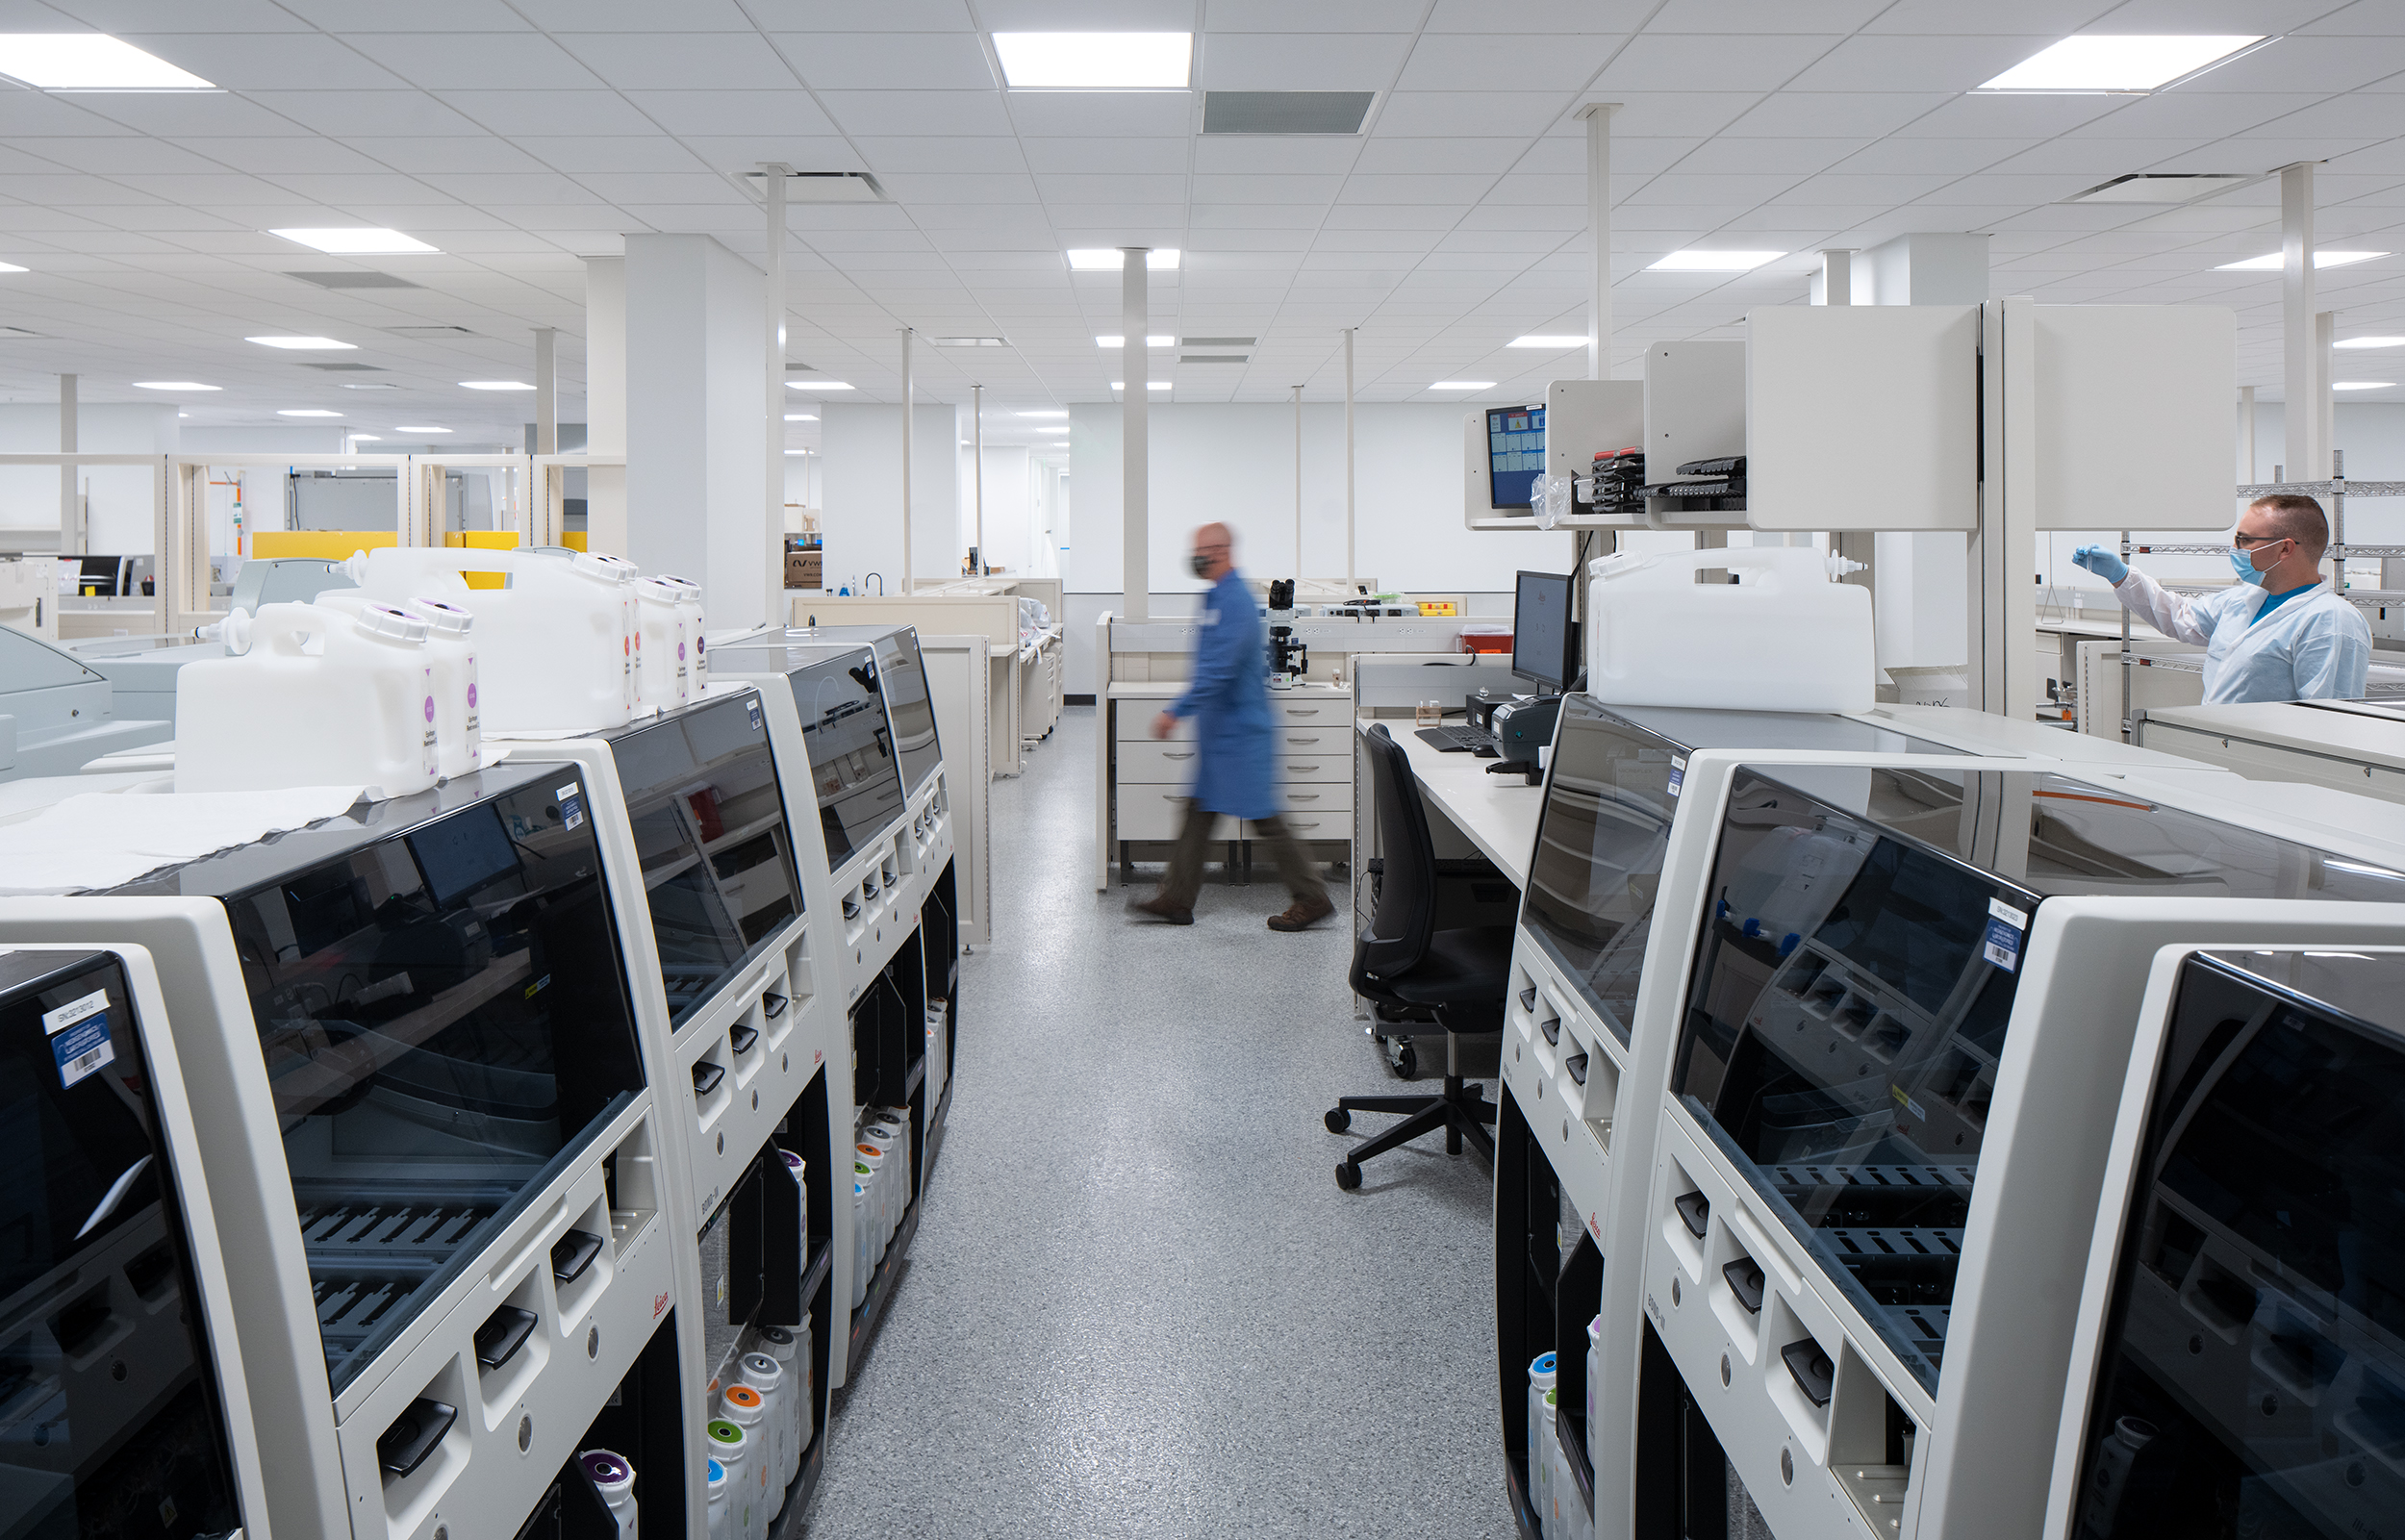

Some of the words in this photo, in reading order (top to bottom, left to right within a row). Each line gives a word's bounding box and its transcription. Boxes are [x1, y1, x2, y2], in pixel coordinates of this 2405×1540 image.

[701, 1185, 720, 1215] BOND-III
[1590, 1212, 1601, 1240] Leica
[653, 1291, 669, 1320] Leica
